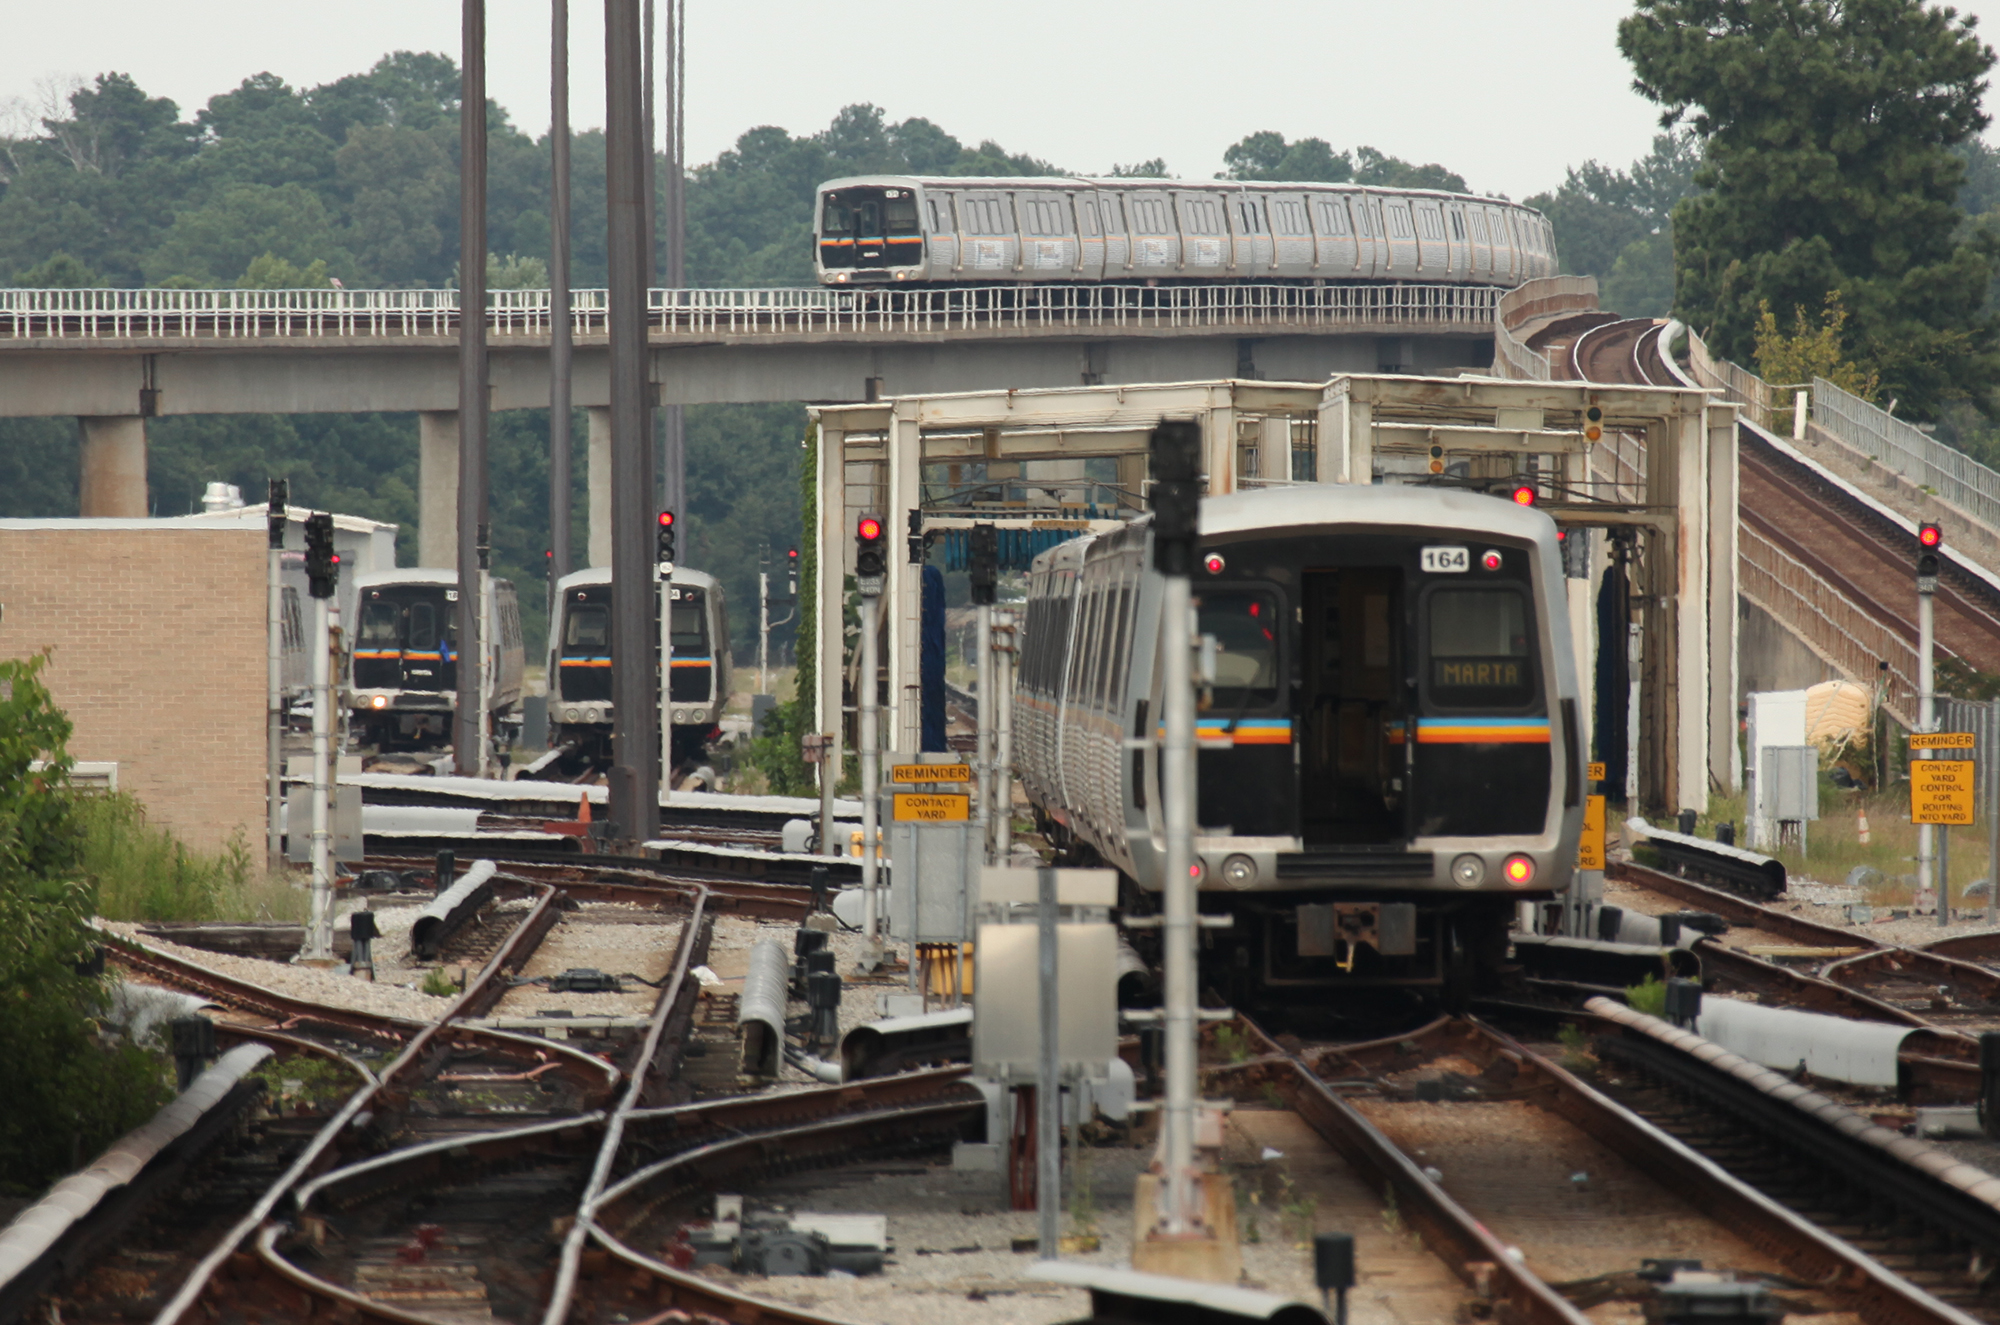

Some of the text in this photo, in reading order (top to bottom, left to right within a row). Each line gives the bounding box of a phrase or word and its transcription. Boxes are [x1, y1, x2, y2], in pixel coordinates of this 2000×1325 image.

[1425, 551, 1466, 568] 164
[1442, 663, 1518, 685] MARTA
[1911, 735, 1973, 746] REMINDER
[1920, 764, 1964, 772] CONTACT
[895, 767, 968, 779] REMINDER
[1931, 774, 1956, 782] YARD
[1920, 784, 1965, 792] CONTROL
[1933, 794, 1952, 802] FOR
[905, 798, 957, 808] CONTACT
[1922, 803, 1963, 811] ROUTING
[917, 810, 946, 819] YARD
